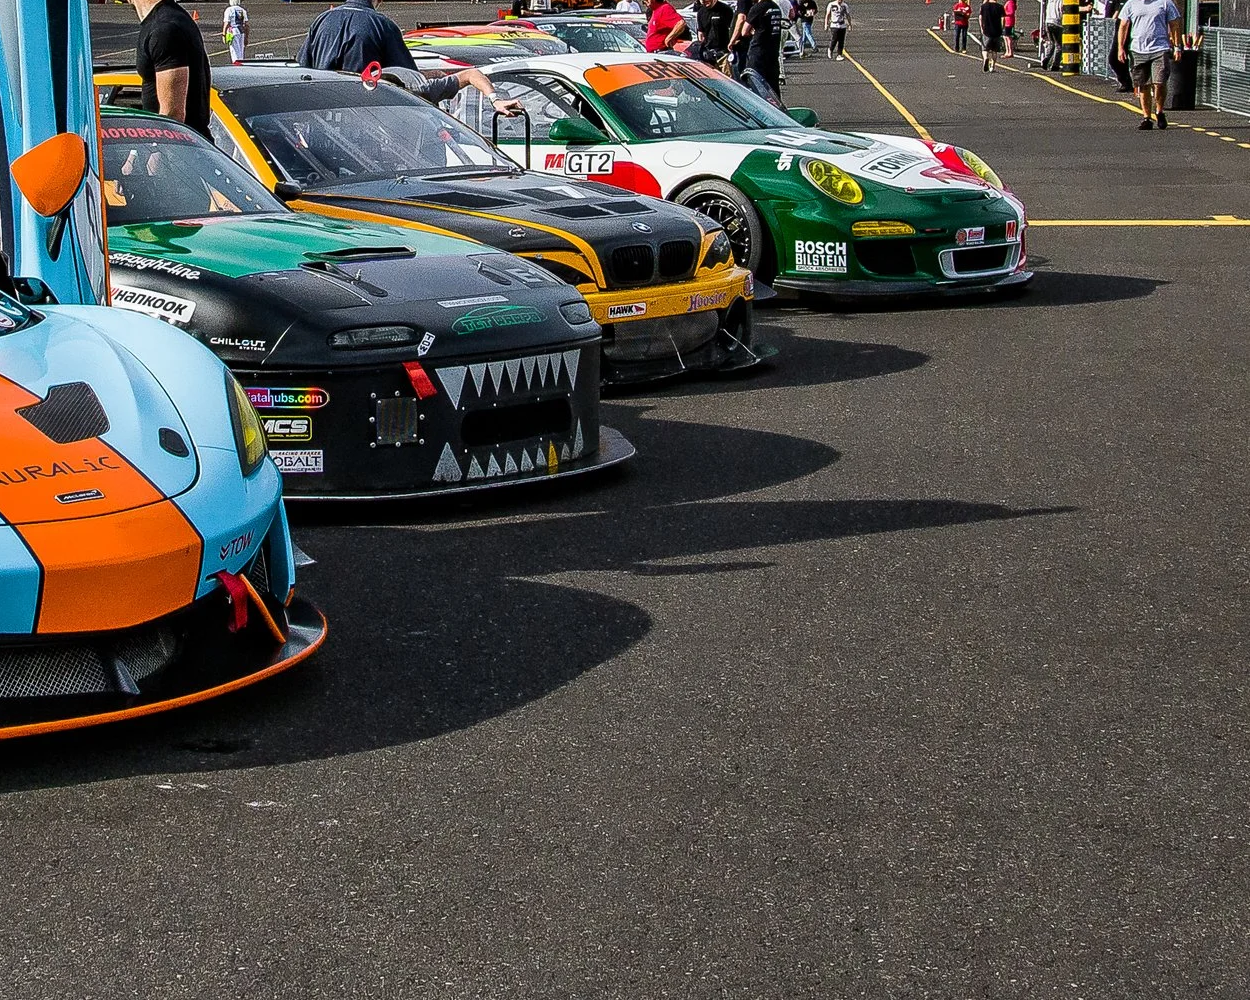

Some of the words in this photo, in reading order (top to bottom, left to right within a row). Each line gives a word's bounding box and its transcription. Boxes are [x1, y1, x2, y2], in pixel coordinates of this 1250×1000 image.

[568, 153, 610, 173] GT2
[795, 239, 846, 255] BOSCH
[796, 253, 846, 267] BILSTEIN
[687, 291, 727, 312] Hoosier
[609, 304, 634, 317] HAWK
[210, 337, 266, 347] CHILLOUT
[419, 333, 434, 353] TOW
[248, 392, 323, 404] iatahubs.com
[263, 419, 309, 433] MCS
[272, 456, 322, 467] OBALT
[63, 490, 96, 501] McLaren
[229, 530, 255, 559] TOW
